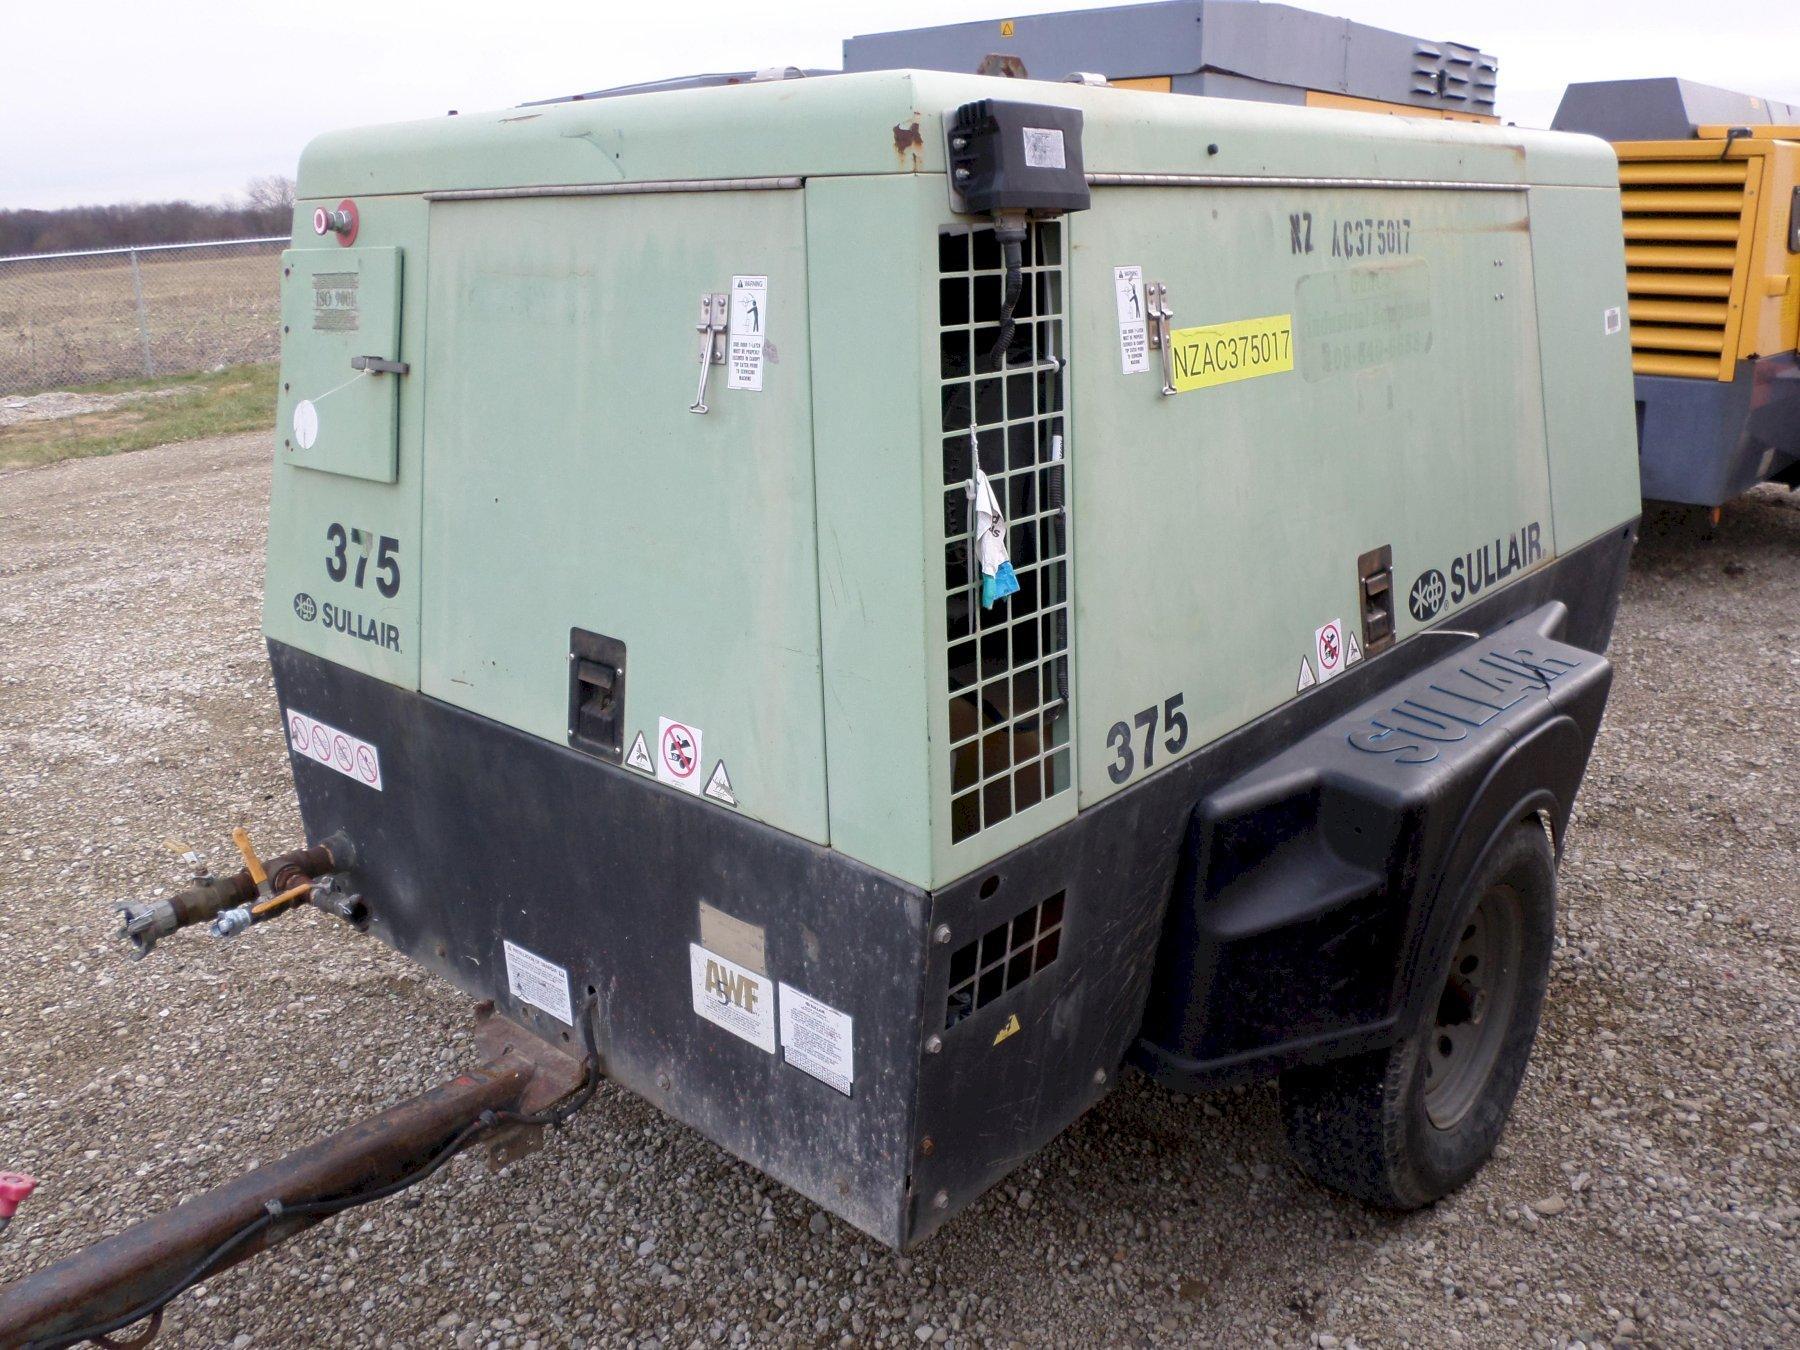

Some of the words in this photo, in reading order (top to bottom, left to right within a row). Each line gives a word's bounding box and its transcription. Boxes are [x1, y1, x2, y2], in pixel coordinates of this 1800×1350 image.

[1289, 211, 1314, 255] NZ
[316, 290, 332, 307] ISO
[334, 290, 356, 308] 9001
[1173, 330, 1291, 380] NZAC375017
[325, 522, 401, 599] 375
[1450, 521, 1543, 605] SULLAIR
[322, 602, 400, 652] SULLAIR
[1347, 649, 1581, 764] SULLAIR
[1106, 692, 1189, 785] 375
[704, 958, 759, 1014] AWF
